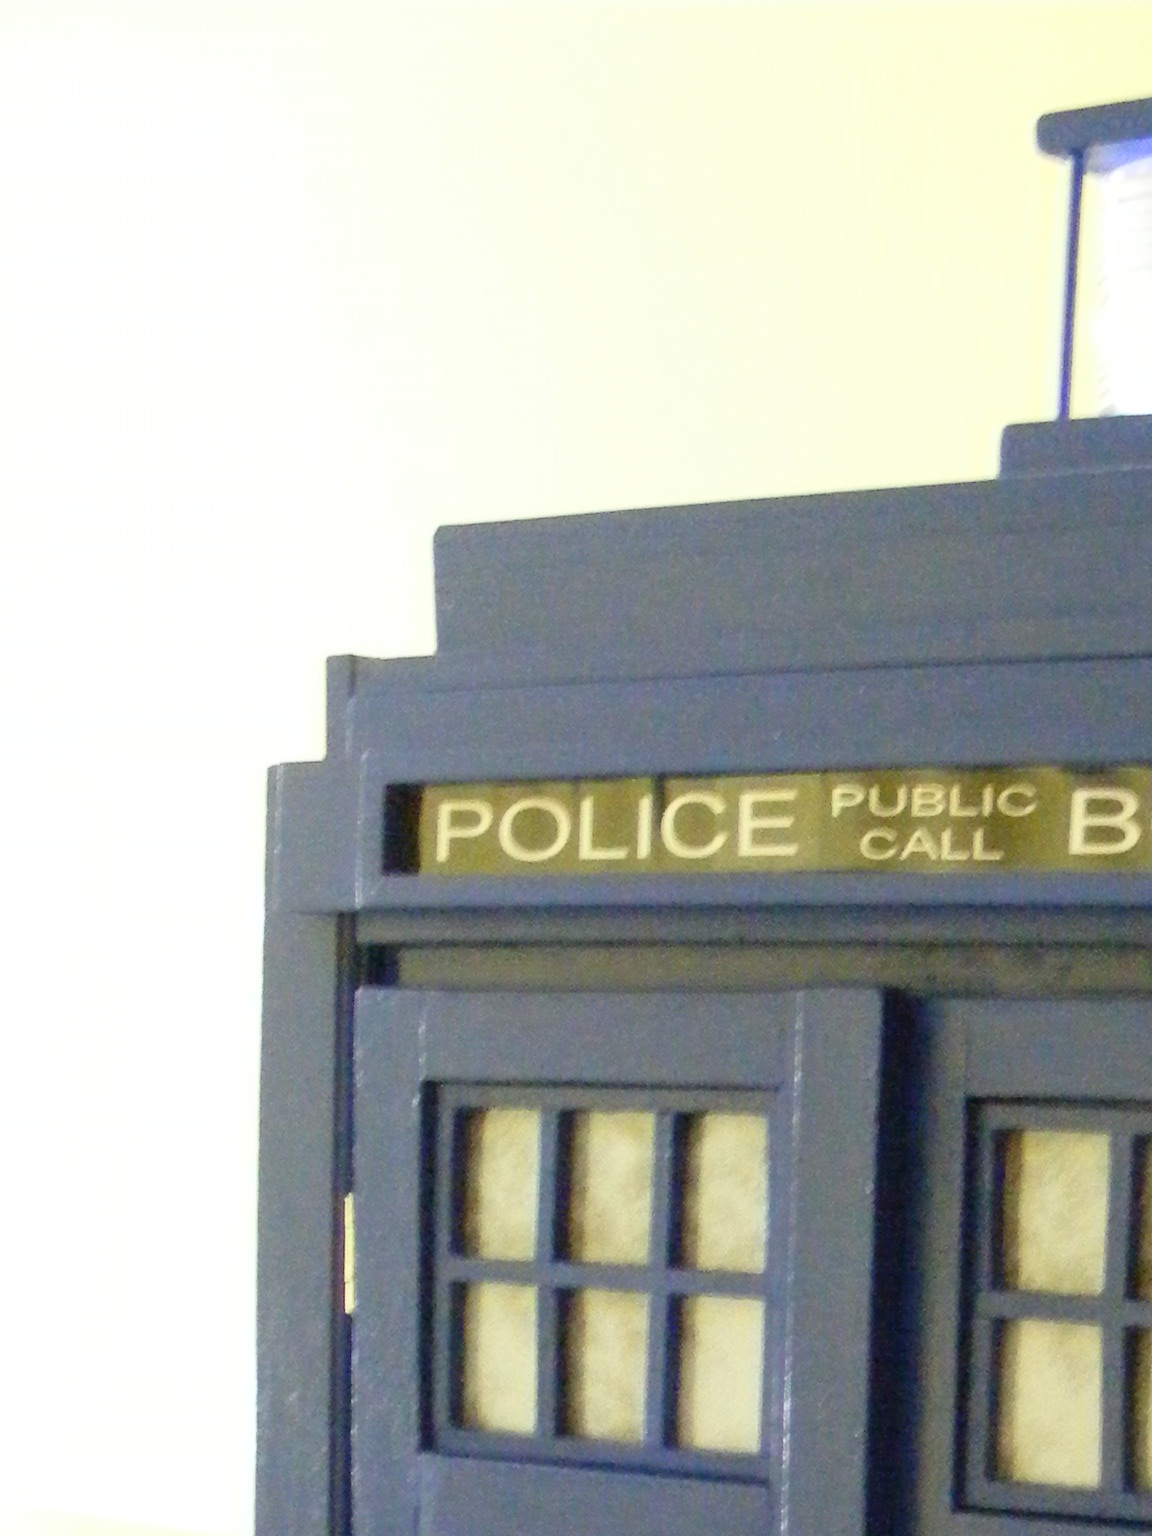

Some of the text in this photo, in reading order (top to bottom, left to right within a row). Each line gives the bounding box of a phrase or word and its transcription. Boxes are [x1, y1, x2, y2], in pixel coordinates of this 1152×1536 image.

[830, 783, 1038, 818] PUBLIC
[434, 787, 800, 863] POLICE
[858, 826, 1004, 861] CALL
